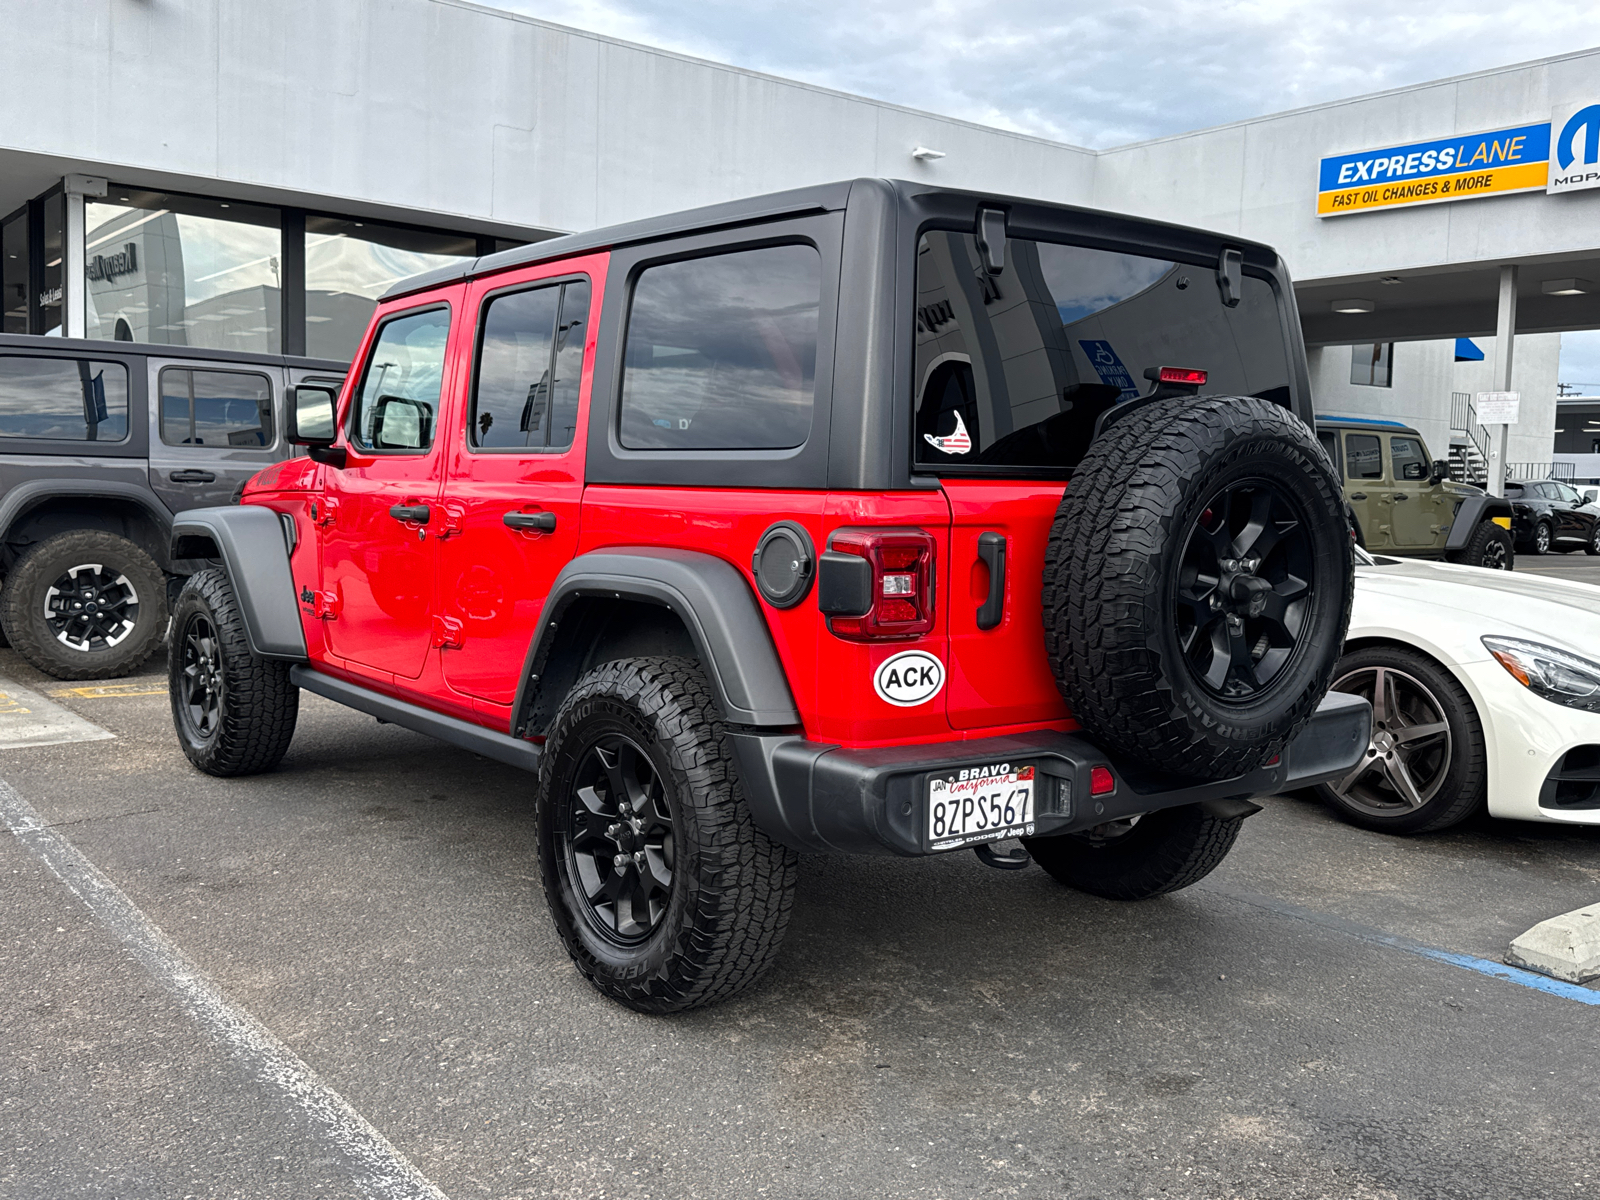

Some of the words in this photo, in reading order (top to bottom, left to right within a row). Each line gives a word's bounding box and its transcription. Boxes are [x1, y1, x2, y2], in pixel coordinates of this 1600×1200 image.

[1554, 172, 1600, 186] MOP
[1332, 192, 1360, 207] FAST
[1362, 190, 1379, 204] OIL
[1382, 182, 1438, 201] CHANGES
[1441, 180, 1451, 192] &
[1454, 174, 1493, 192] MORE
[301, 584, 315, 604] Jee
[885, 665, 935, 689] ACK
[959, 763, 1010, 780] BRAVO
[932, 781, 946, 792] JAN
[948, 773, 1018, 795] California
[933, 788, 1030, 838] 8ZPS567
[1007, 828, 1024, 837] Jeep
